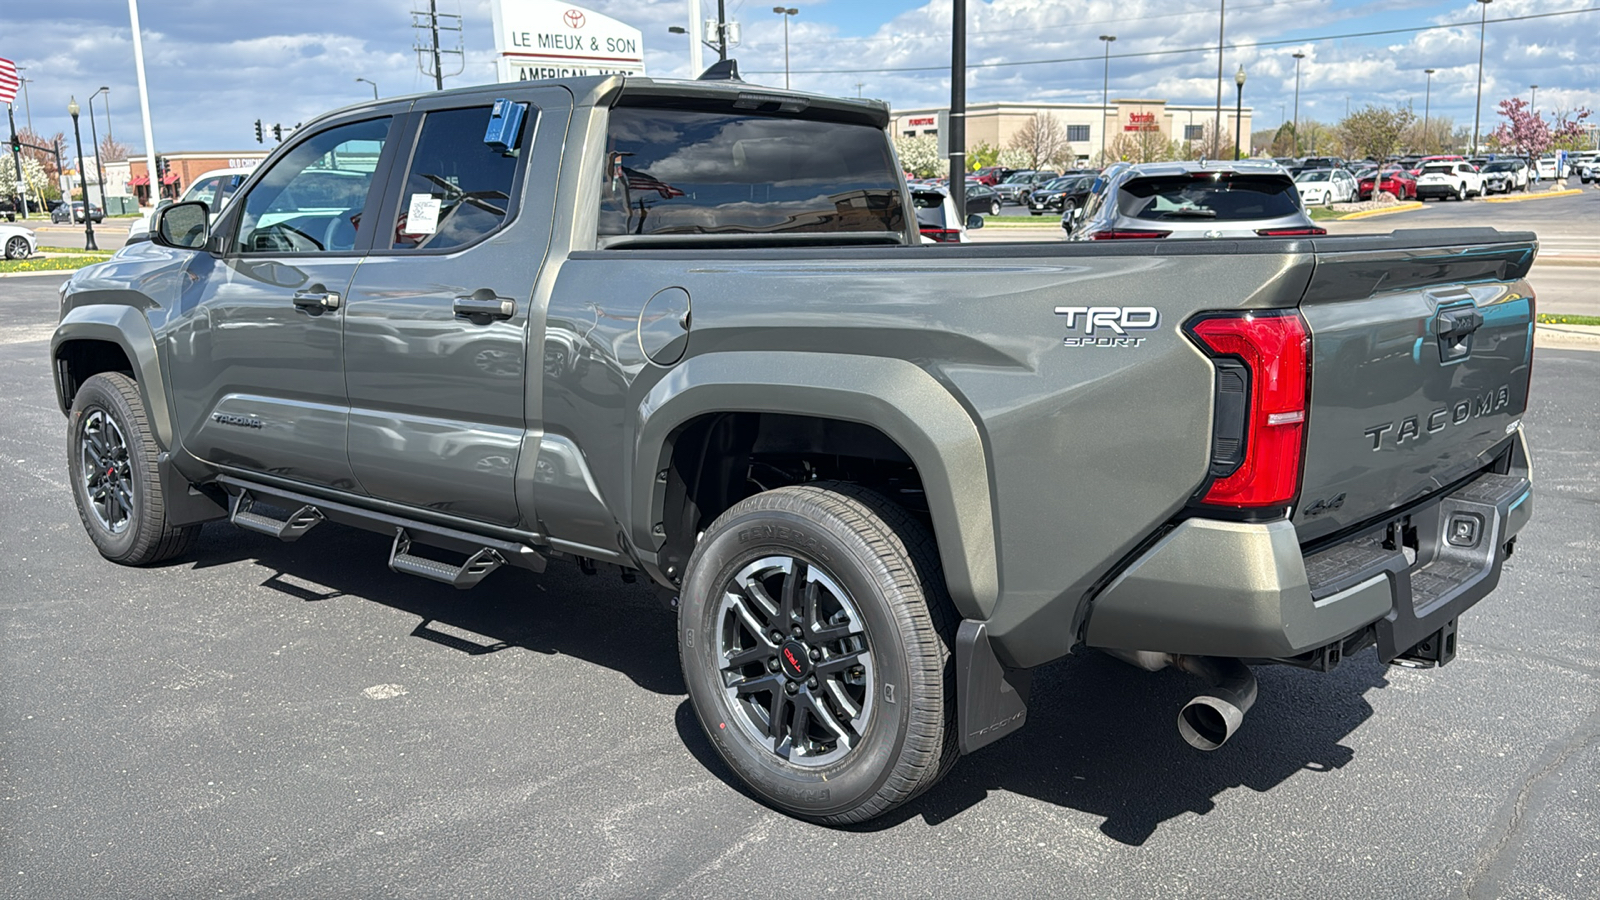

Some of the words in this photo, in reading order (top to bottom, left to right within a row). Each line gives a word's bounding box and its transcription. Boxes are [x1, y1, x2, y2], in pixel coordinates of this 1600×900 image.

[512, 31, 531, 47] LE
[538, 33, 584, 51] MIEUX
[590, 36, 600, 51] &
[606, 37, 636, 53] SON
[229, 158, 241, 168] OLD
[1054, 306, 1161, 335] TRD
[1063, 337, 1147, 348] SPORT
[213, 412, 262, 429] TACOMA
[1363, 384, 1511, 452] TACOMA
[737, 523, 831, 563] GENERAL
[783, 647, 802, 674] TRD
